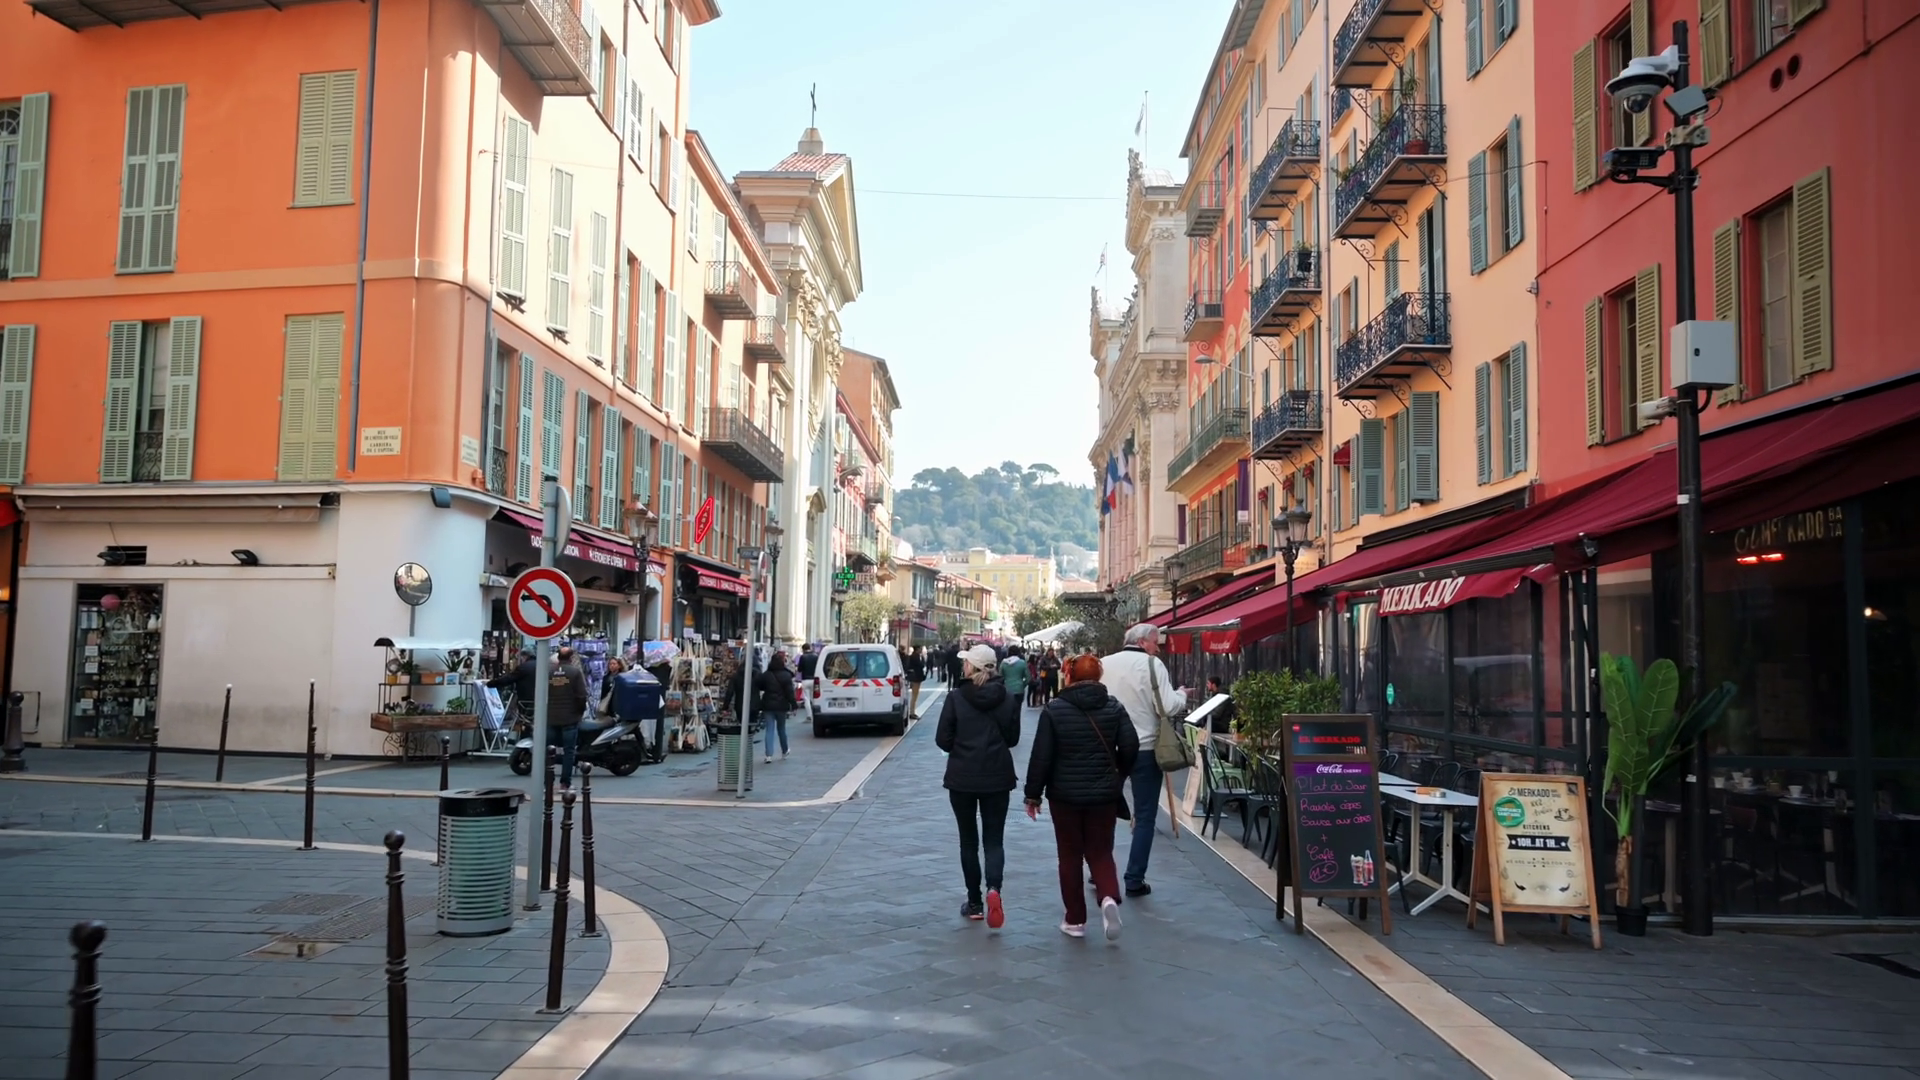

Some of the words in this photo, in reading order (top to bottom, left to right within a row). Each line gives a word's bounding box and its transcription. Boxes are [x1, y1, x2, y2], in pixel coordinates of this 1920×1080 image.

[698, 505, 710, 535] TABAC
[1379, 576, 1466, 614] MERKADO
[1298, 735, 1310, 743] EL
[1312, 735, 1361, 743] MERKADO
[1295, 776, 1327, 792] Plat
[1330, 780, 1343, 791] du
[1517, 787, 1551, 798] MERKADO
